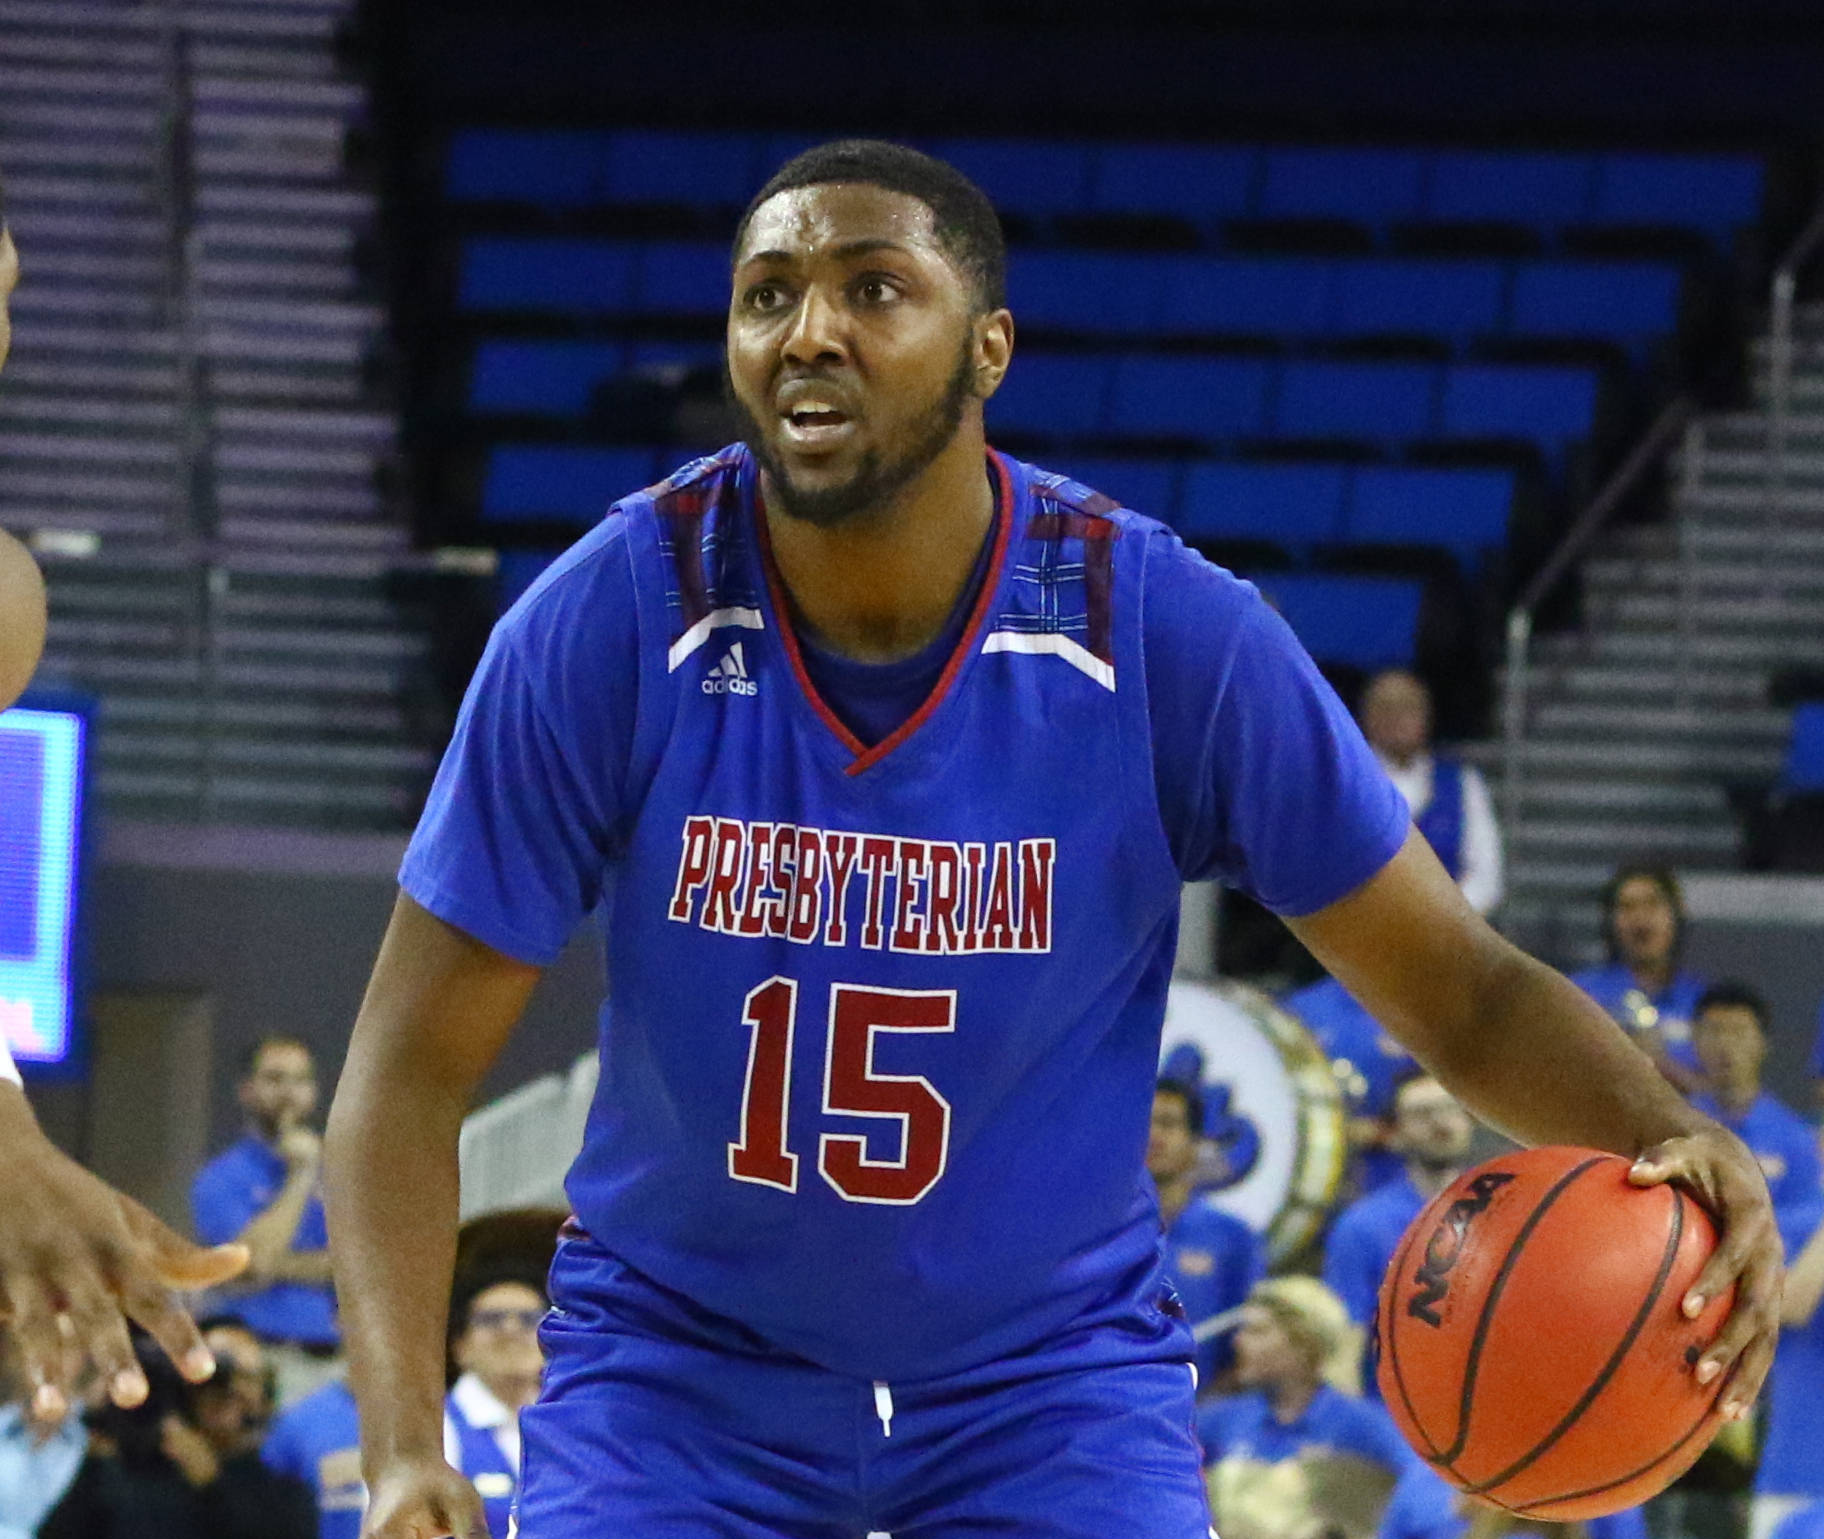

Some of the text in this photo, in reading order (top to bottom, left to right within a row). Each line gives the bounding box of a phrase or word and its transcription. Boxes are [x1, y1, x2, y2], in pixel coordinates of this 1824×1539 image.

[668, 815, 1056, 955] PRESBYTERIAN
[728, 974, 957, 1205] 15
[1407, 1172, 1517, 1329] NCAA
